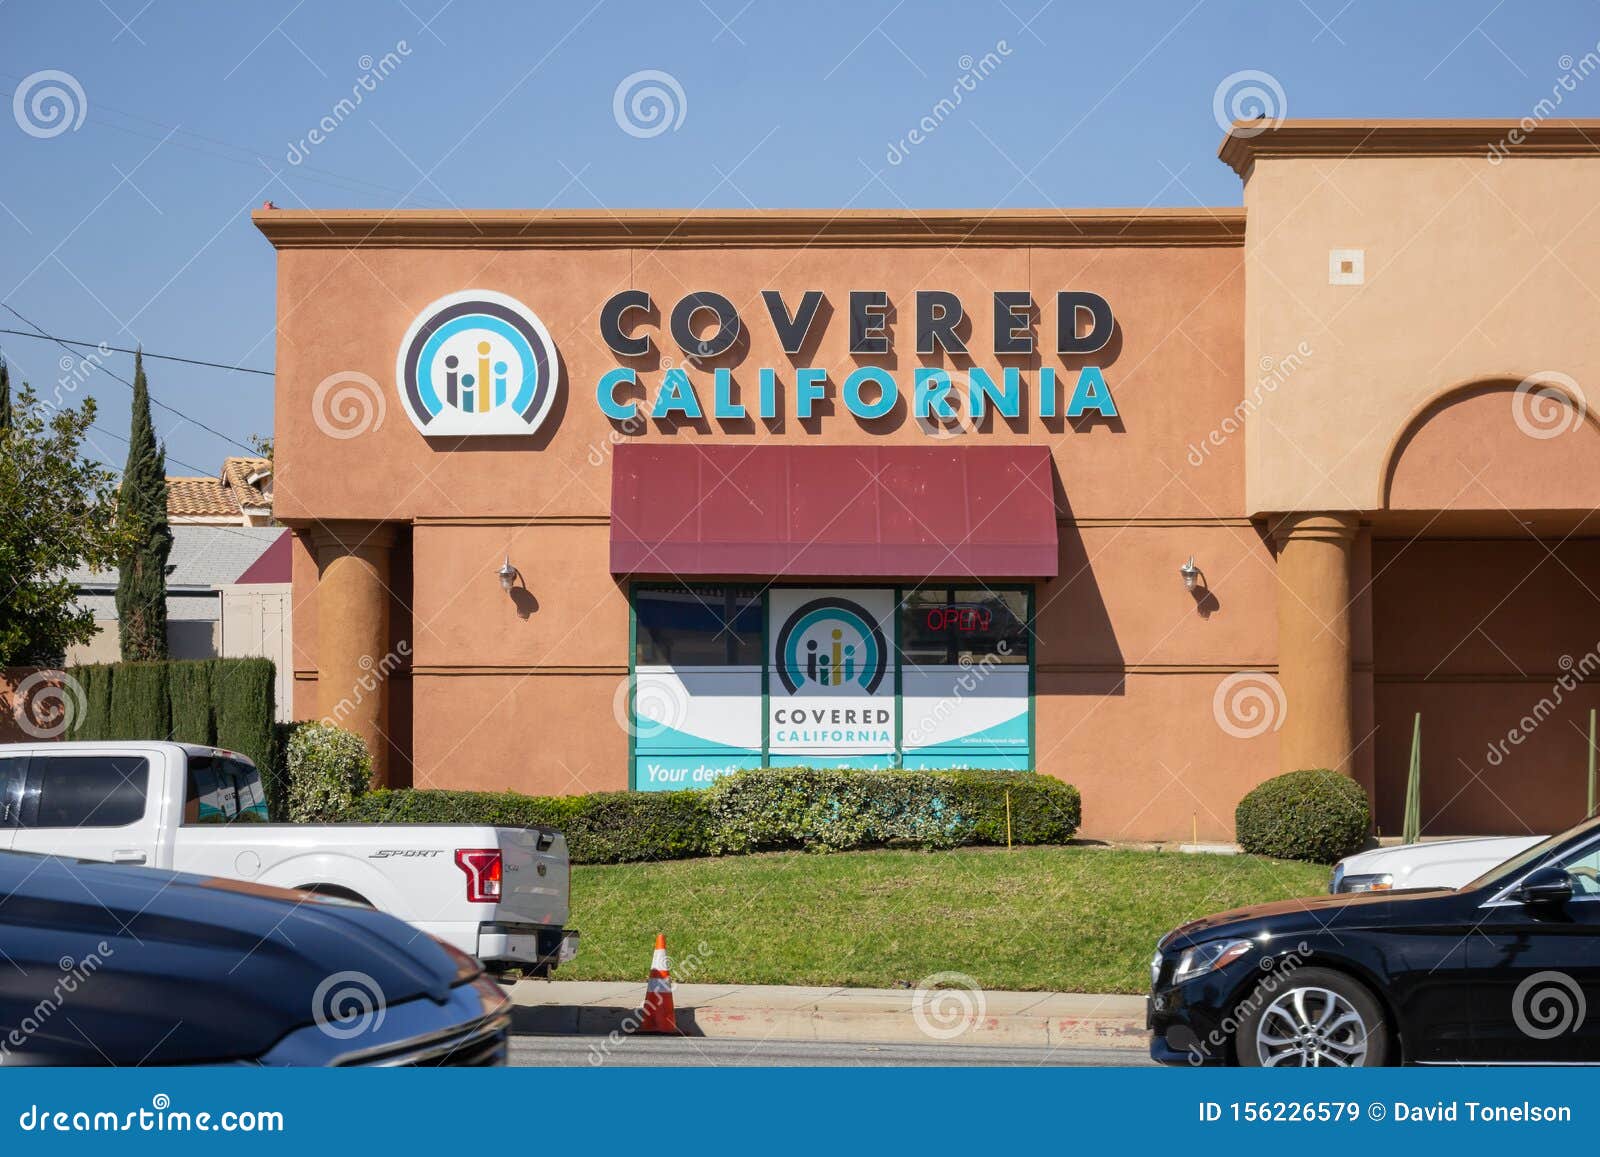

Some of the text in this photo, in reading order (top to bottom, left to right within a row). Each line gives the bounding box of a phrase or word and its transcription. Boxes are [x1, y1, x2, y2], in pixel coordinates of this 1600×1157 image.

[600, 290, 1115, 356] COVERED
[596, 366, 1118, 419] CALIFORNIA
[927, 608, 990, 631] OPEN
[775, 709, 890, 724] COVERED
[776, 730, 891, 742] CALIFORNIA
[648, 764, 689, 782] Your
[368, 850, 446, 859] SPORT
